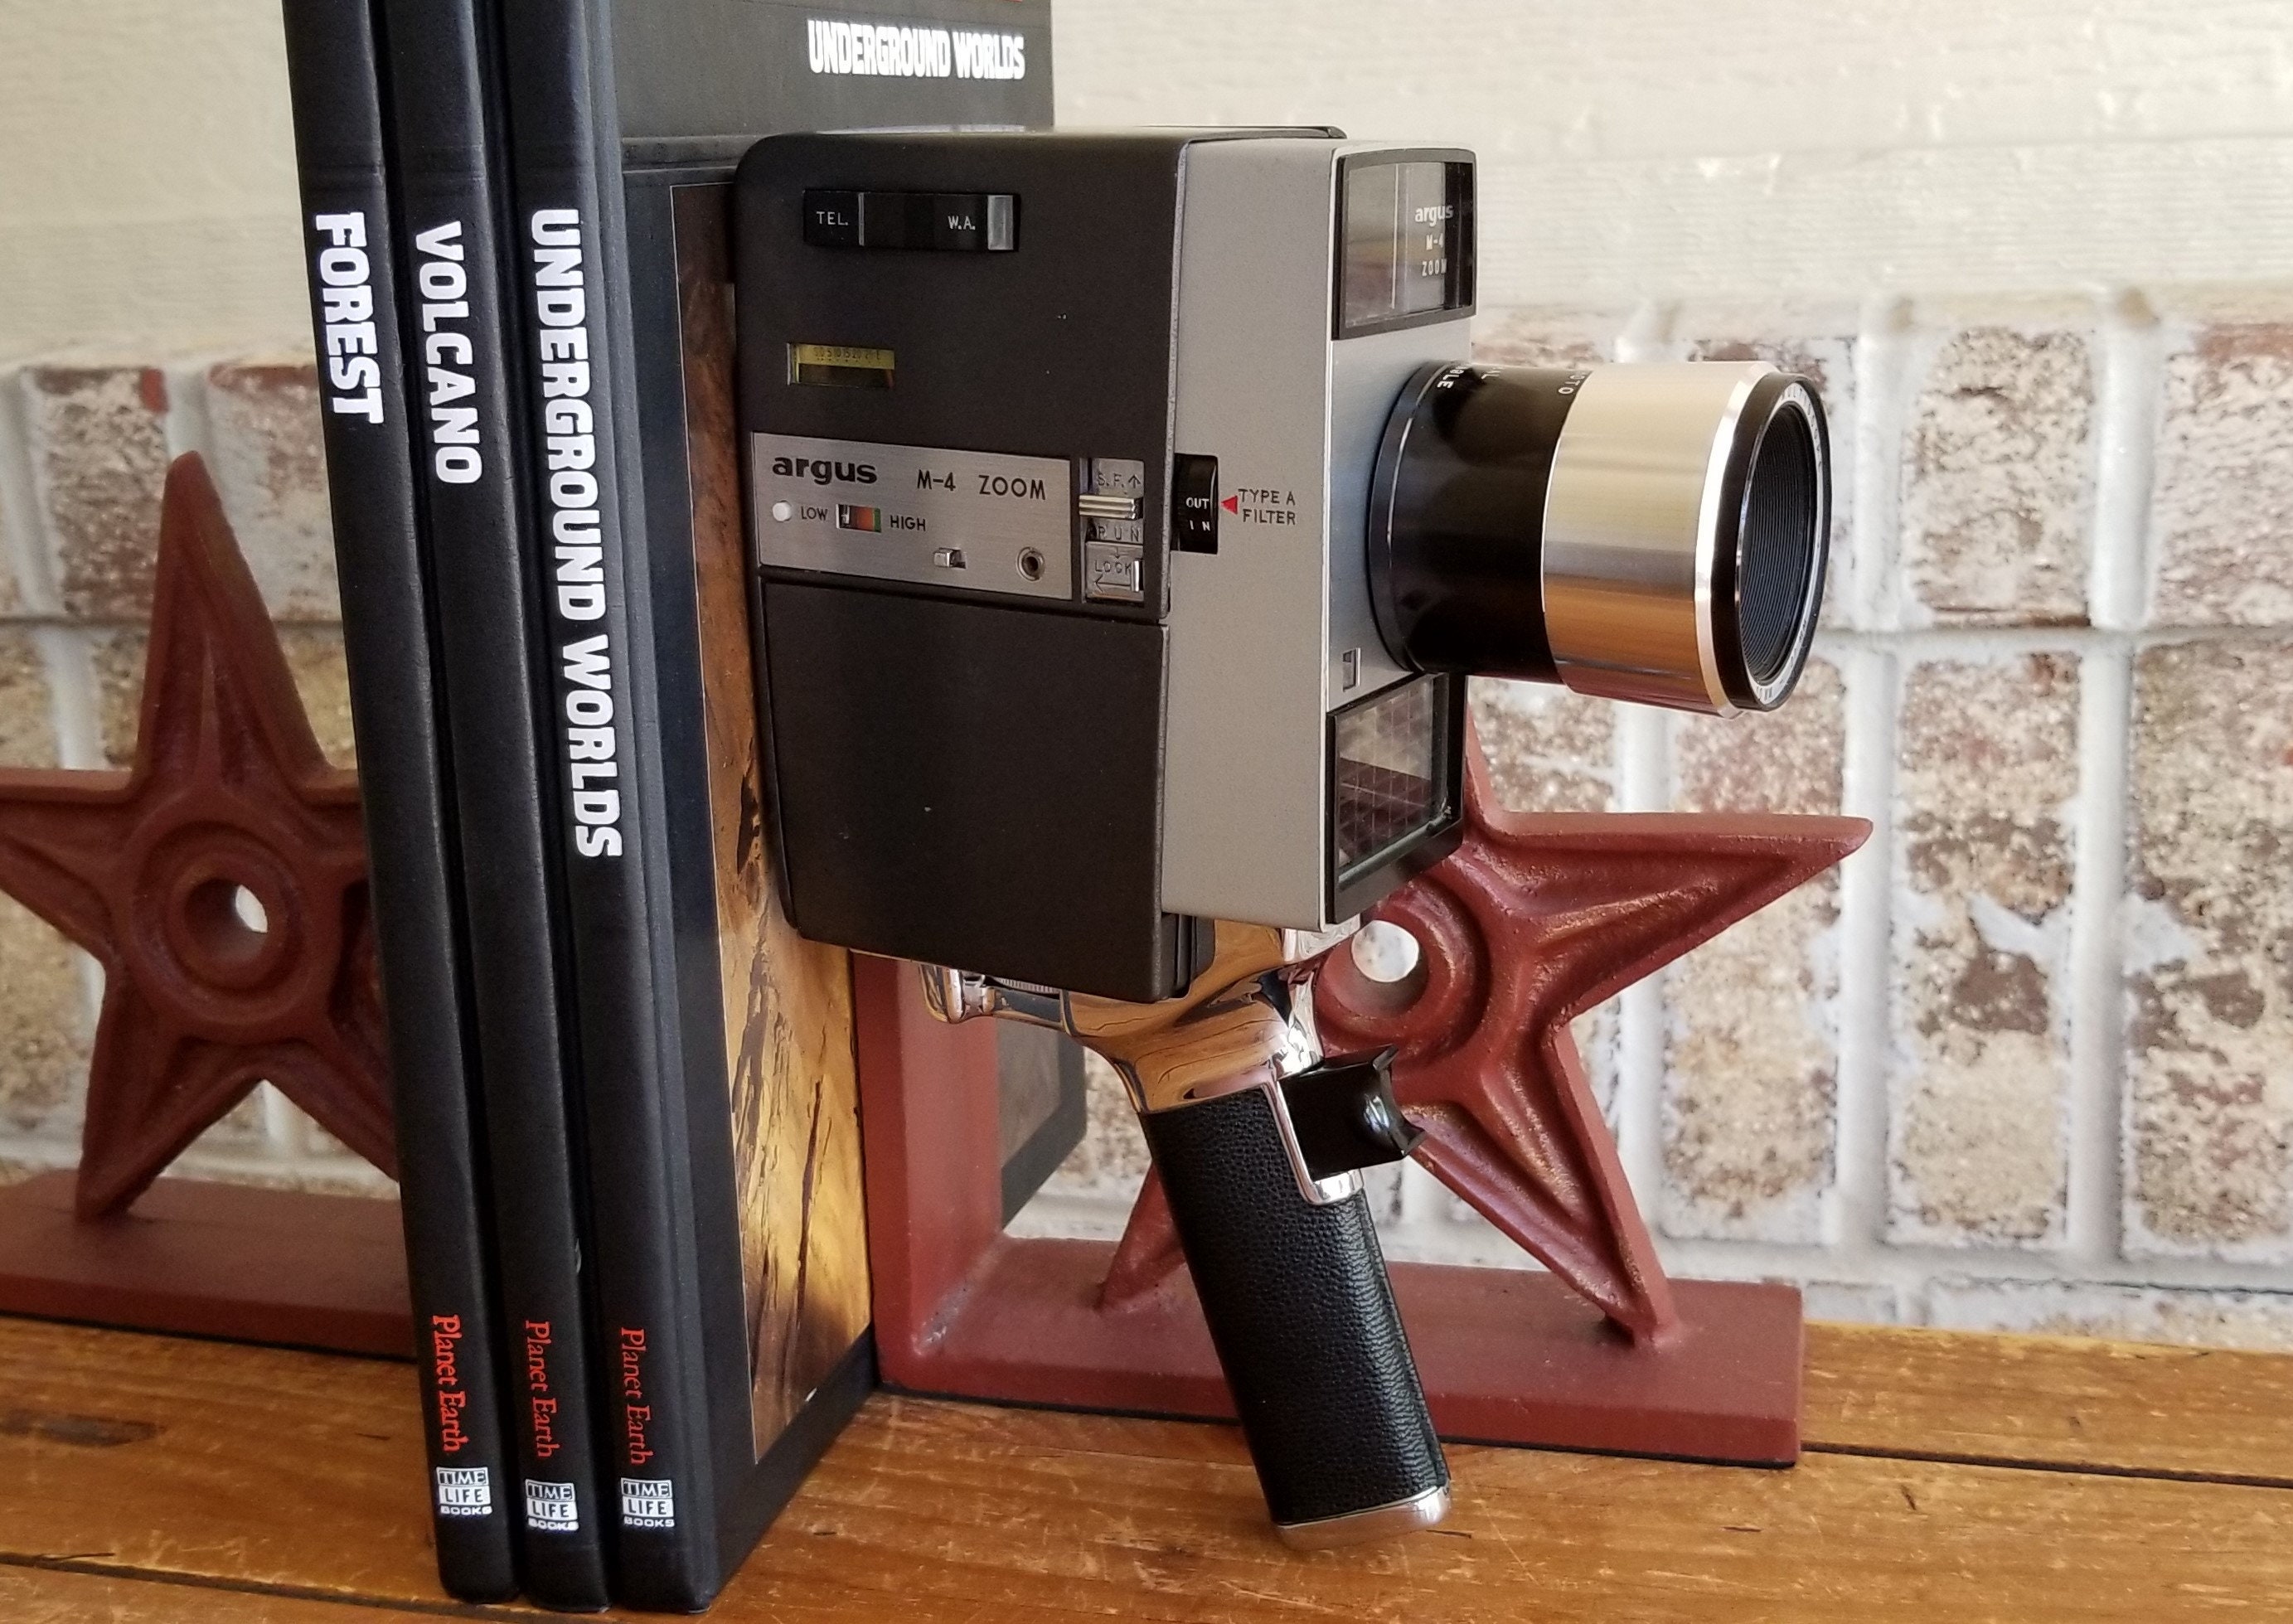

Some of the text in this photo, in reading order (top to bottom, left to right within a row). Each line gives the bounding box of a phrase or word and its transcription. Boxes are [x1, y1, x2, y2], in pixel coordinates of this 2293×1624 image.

[807, 19, 1026, 80] UNDERGROUND WORLDS
[816, 211, 849, 226] TEL.
[948, 216, 976, 230] W.A.
[1414, 205, 1454, 227] argus
[1426, 233, 1444, 250] M-4
[1422, 259, 1447, 277] ZOOM
[315, 211, 384, 425] FOREST
[414, 221, 483, 485] VOLCANO
[772, 456, 1046, 501] argus M-4 ZOOM
[1185, 497, 1210, 510] OUT
[1238, 488, 1296, 506] TYPE A
[801, 506, 828, 521] LOW
[1243, 508, 1296, 526] FILTER
[890, 515, 926, 531] HIGH
[531, 208, 623, 859] UNDERGROUND WORLDS
[1097, 525, 1141, 541] RUN
[432, 1314, 469, 1453] Planet Earth
[525, 1320, 560, 1458] Planet Earth
[621, 1327, 654, 1466] Planet Earth
[439, 1469, 486, 1486] TIME
[445, 1487, 484, 1503] LIFE
[528, 1481, 573, 1500] TIME
[623, 1481, 671, 1498] TIME
[439, 1505, 492, 1515] BOOKS
[532, 1501, 570, 1519] LIFE
[628, 1500, 667, 1515] LIFE
[527, 1518, 579, 1531] BOOKS
[623, 1515, 675, 1528] BOOKS
